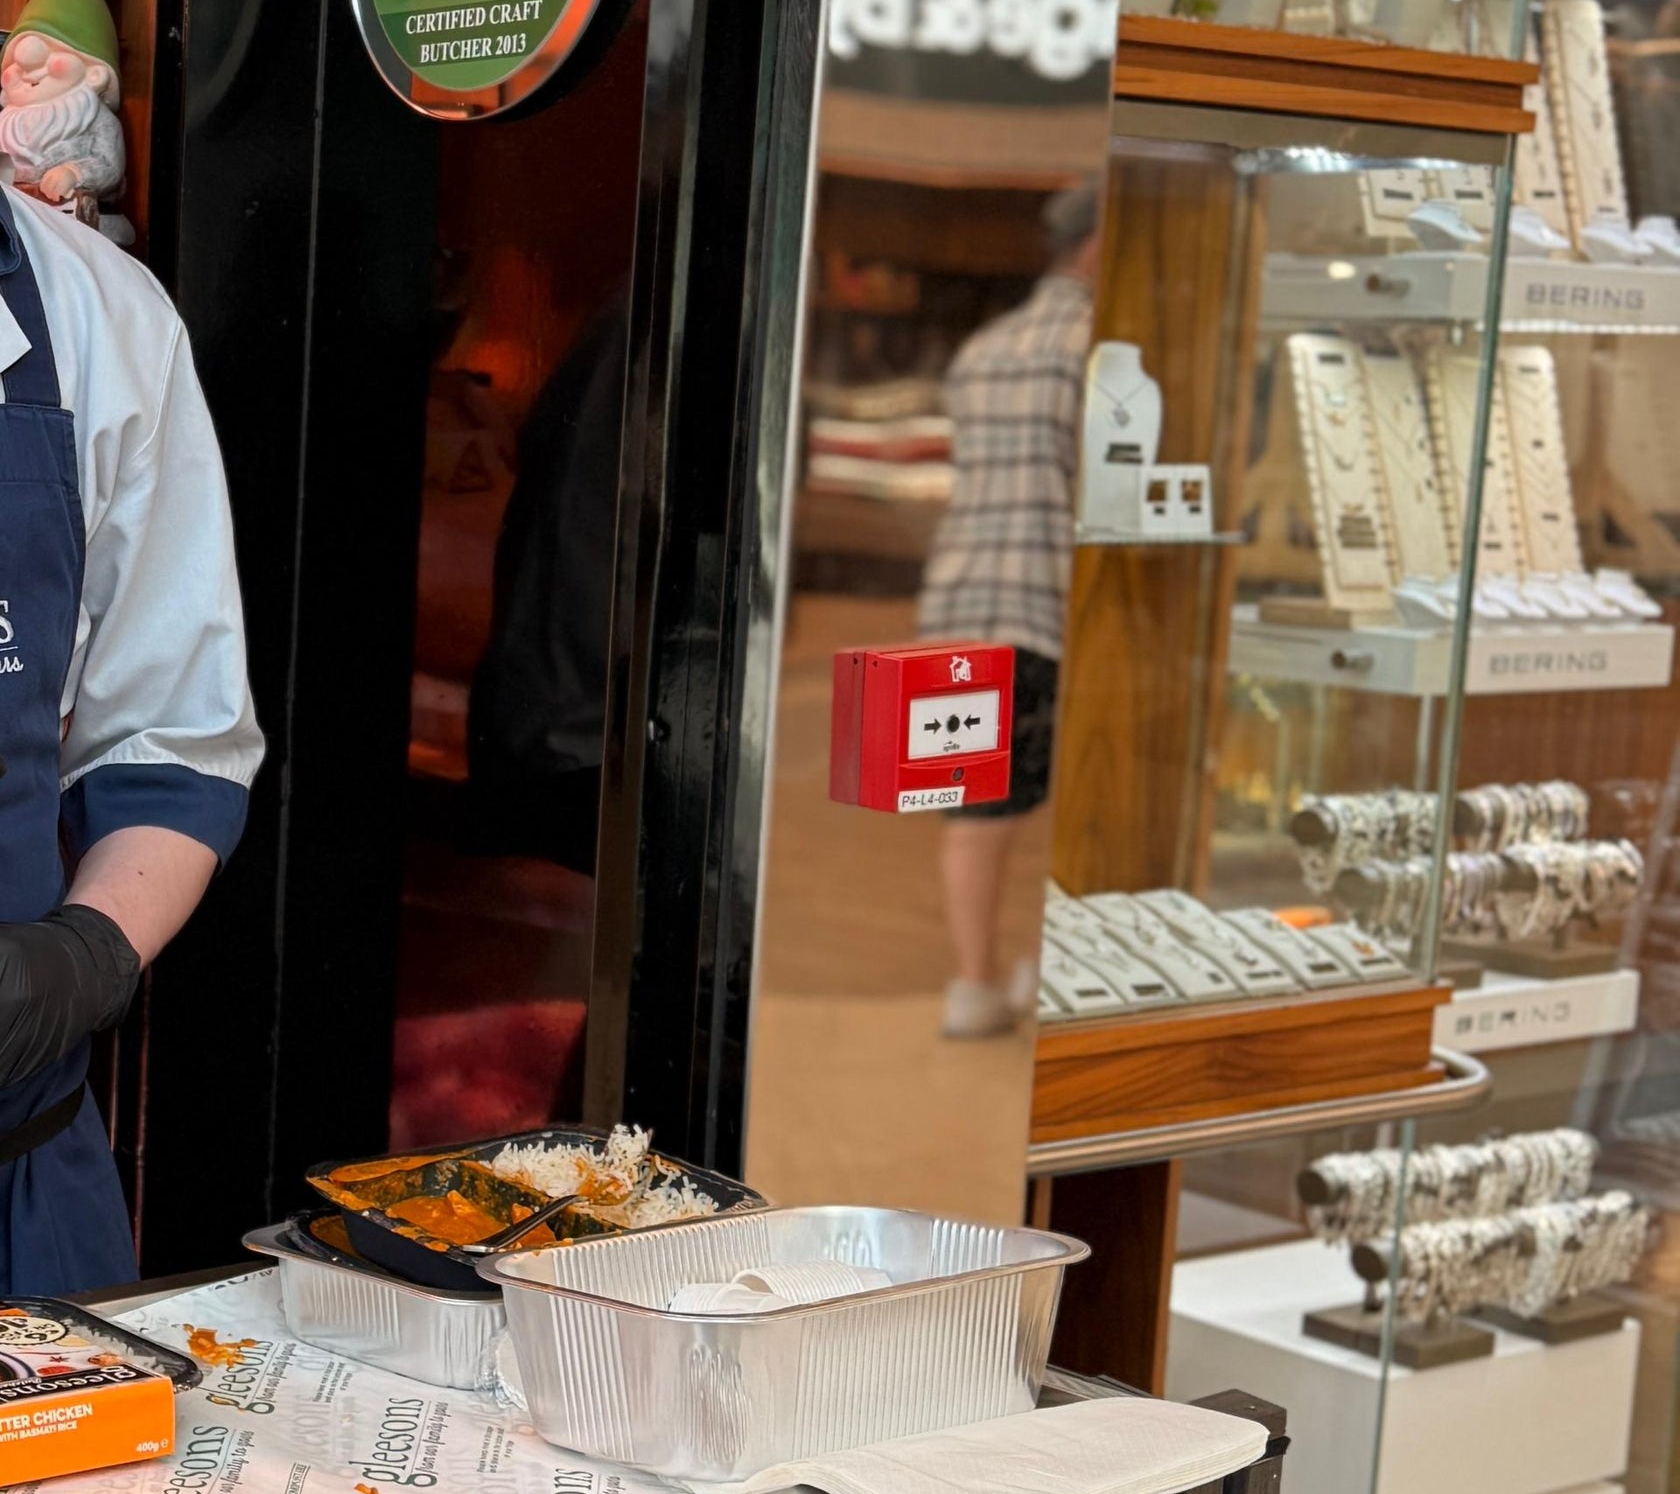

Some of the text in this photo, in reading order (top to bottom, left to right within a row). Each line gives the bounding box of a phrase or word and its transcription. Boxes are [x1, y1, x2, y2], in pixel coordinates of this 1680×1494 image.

[405, 5, 487, 35] CERTIFIED
[419, 32, 527, 65] BUTCHER 2013
[1526, 283, 1646, 308] BERING
[1489, 651, 1608, 675] BERING
[901, 791, 959, 807] P4-L4-033
[0, 1365, 137, 1398] gleesons
[33, 1403, 93, 1427] CHICKEN
[19, 1424, 56, 1440] BASMATI
[57, 1421, 77, 1433] RICE
[348, 1398, 437, 1487] gleesons
[136, 1441, 160, 1453] 400g
